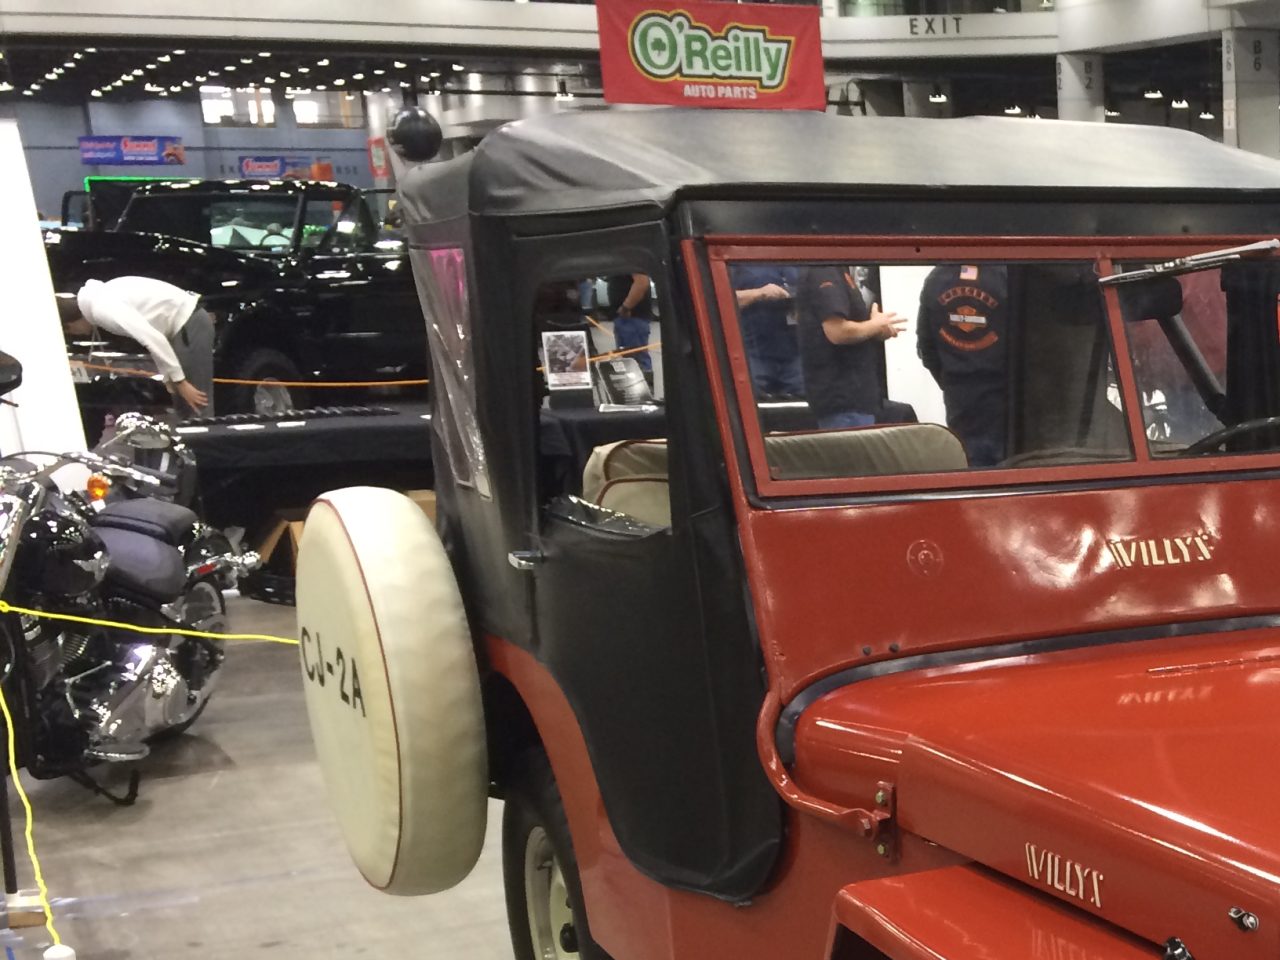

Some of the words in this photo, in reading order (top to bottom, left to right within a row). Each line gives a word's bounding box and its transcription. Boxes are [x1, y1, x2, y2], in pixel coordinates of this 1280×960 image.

[910, 17, 963, 35] EXIT
[637, 20, 784, 81] O'Reilly
[683, 84, 716, 99] AUTO
[717, 85, 757, 99] PARTS
[1107, 534, 1212, 569] WILLYS
[301, 626, 366, 718] CJ-2A
[1025, 842, 1104, 908] WILLYS
